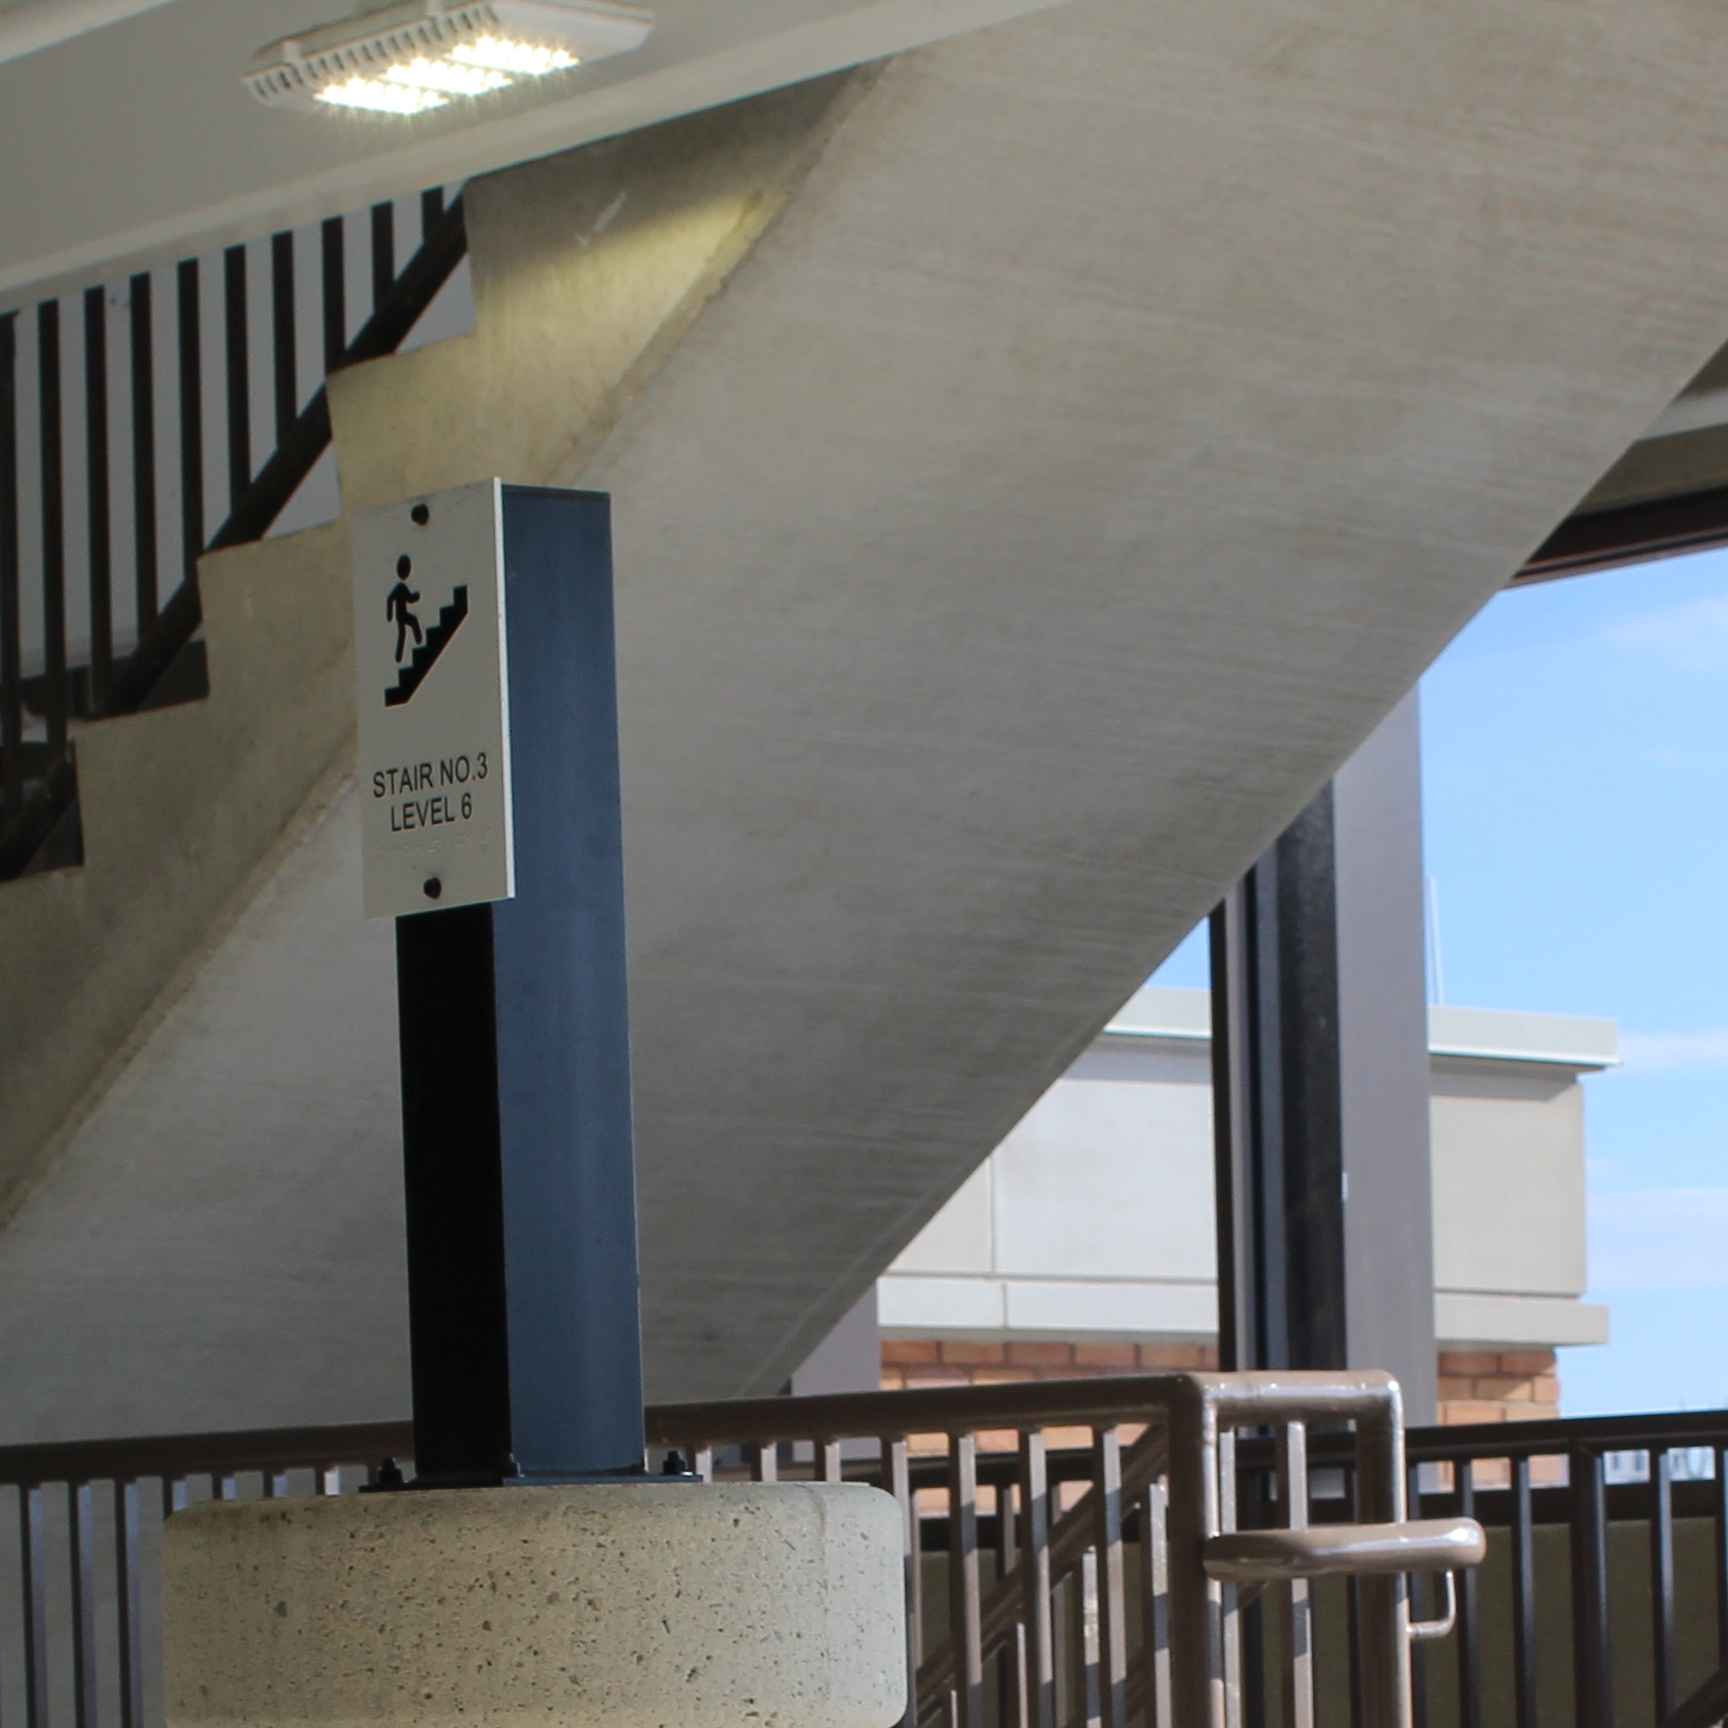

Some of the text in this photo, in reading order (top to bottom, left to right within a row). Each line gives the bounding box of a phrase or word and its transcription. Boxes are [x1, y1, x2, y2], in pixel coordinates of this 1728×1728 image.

[373, 763, 434, 798] STAIR
[391, 793, 473, 832] LEVEL 6
